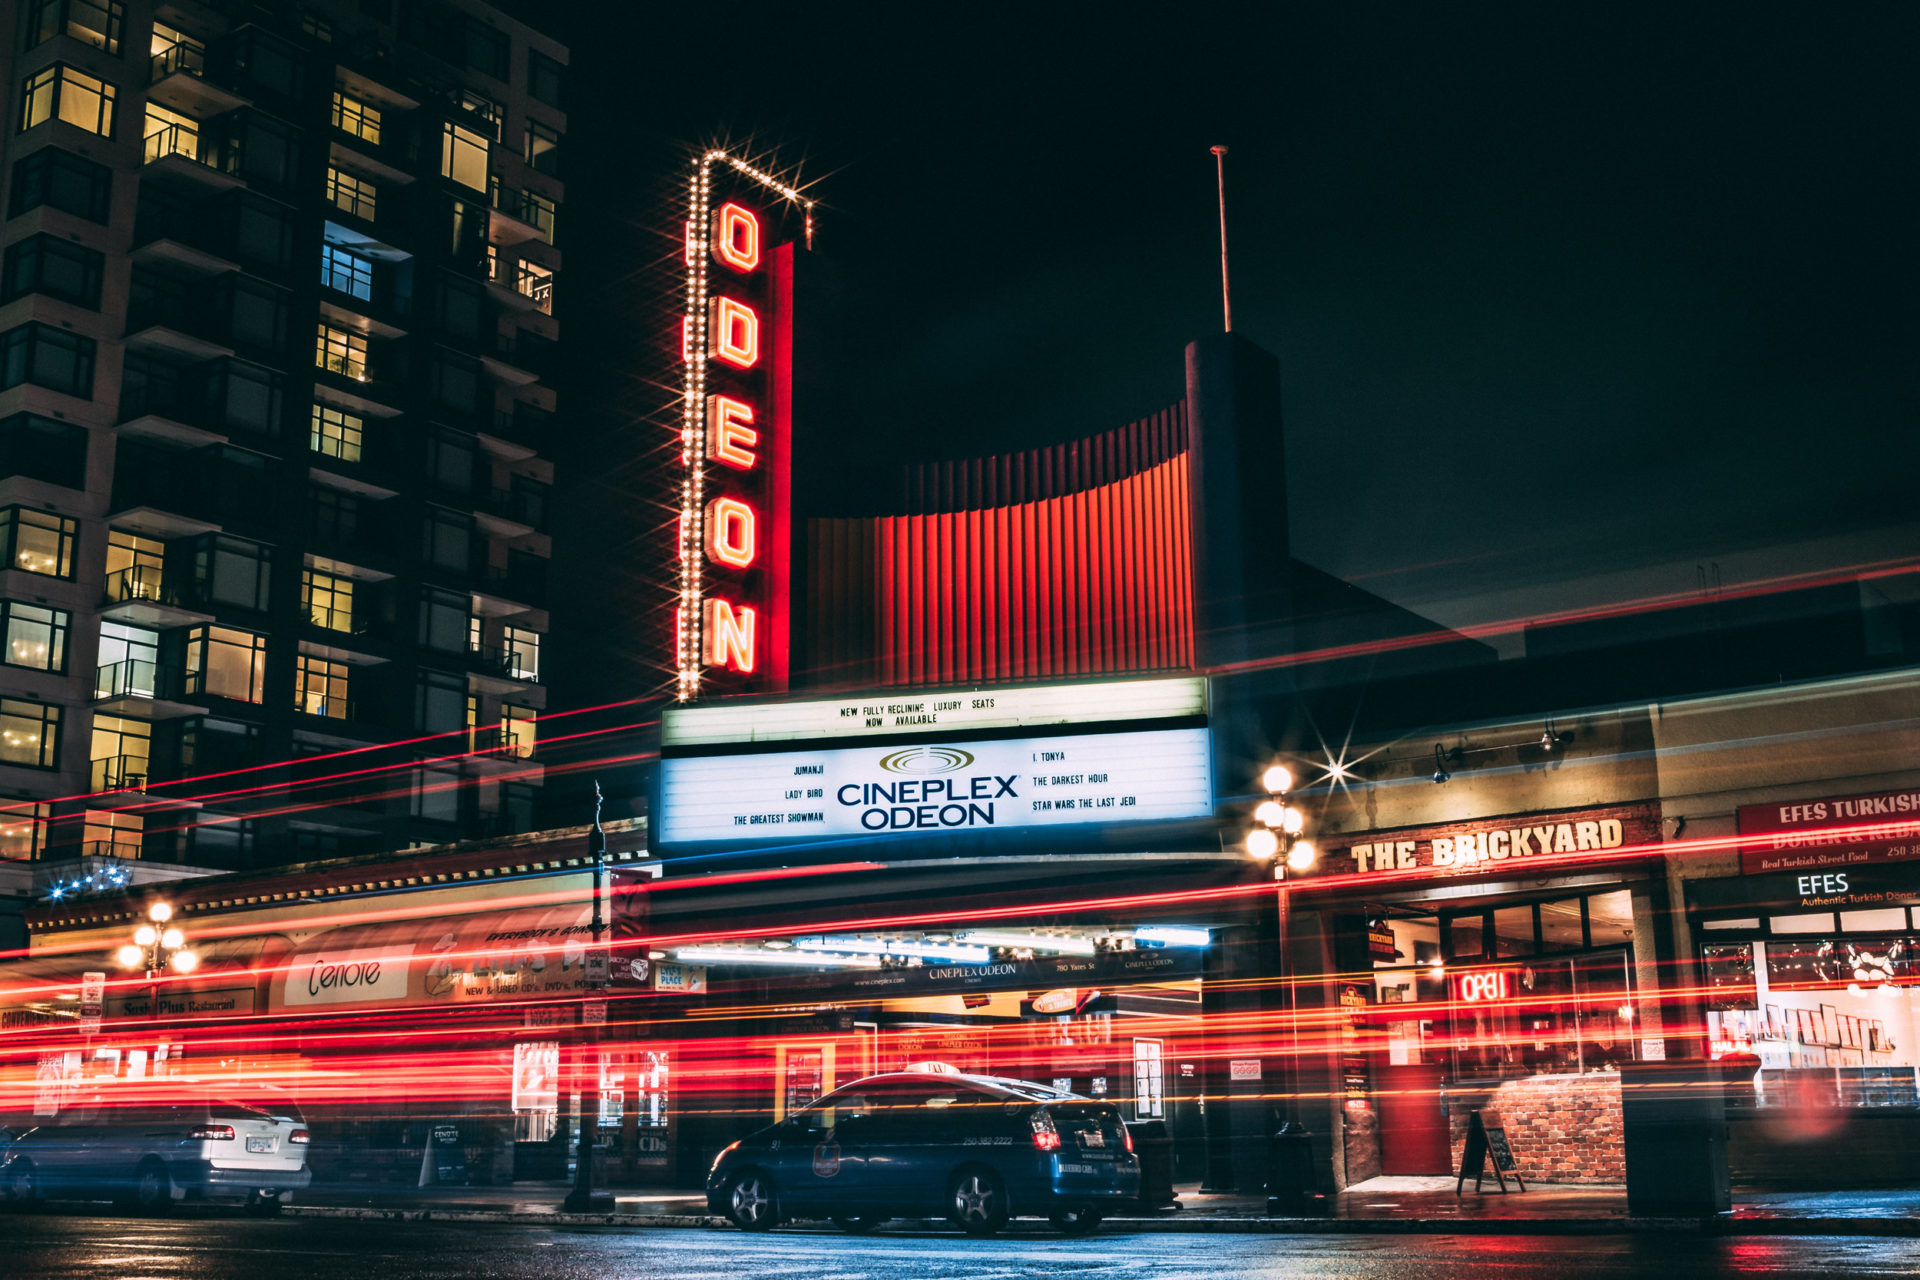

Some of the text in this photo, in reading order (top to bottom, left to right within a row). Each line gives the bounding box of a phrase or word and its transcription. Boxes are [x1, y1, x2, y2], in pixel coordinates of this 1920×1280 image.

[705, 202, 760, 673] ODEON
[841, 699, 995, 717] NEW FULLY RECLINING LUXURY SEATS
[866, 714, 937, 727] NOW AVAILABLE
[1041, 752, 1065, 761] TONYA
[794, 764, 824, 776] JUMANJI
[1033, 774, 1108, 786] THE DARKEST HOUR
[785, 788, 823, 800] LADY BIRD
[837, 775, 1019, 806] CINEPLEX
[1033, 796, 1136, 811] STAR WARS THE LAST JEDI
[1779, 793, 1920, 824] EFES TURKISH
[734, 812, 824, 825] THE GREATEST SHOWMAN
[861, 802, 994, 830] ODEON
[1351, 818, 1624, 873] THE BRICKYARD
[1762, 851, 1868, 870] Real Turkish Street Food
[1797, 873, 1849, 895] EFES
[1802, 895, 1846, 907] Authentic
[1849, 893, 1883, 904] Turkish
[485, 928, 557, 942] EVERYBODY'S
[308, 959, 381, 997] Cenote
[661, 975, 682, 985] PLACE
[854, 977, 905, 986] www.cineplex.com
[929, 967, 977, 980] CINEPLEX
[978, 964, 1017, 977] ODEON
[1070, 963, 1086, 971] Yates
[1125, 960, 1152, 969] CINEPLEX
[1153, 959, 1174, 967] ODEON
[466, 987, 484, 996] NEW
[486, 986, 494, 995] &
[496, 984, 518, 994] USED
[1462, 972, 1505, 1001] OPEN
[123, 1001, 156, 1017] Sush
[159, 1000, 185, 1015] Plus
[928, 1063, 947, 1073] TAXI
[639, 1137, 667, 1152] CDs
